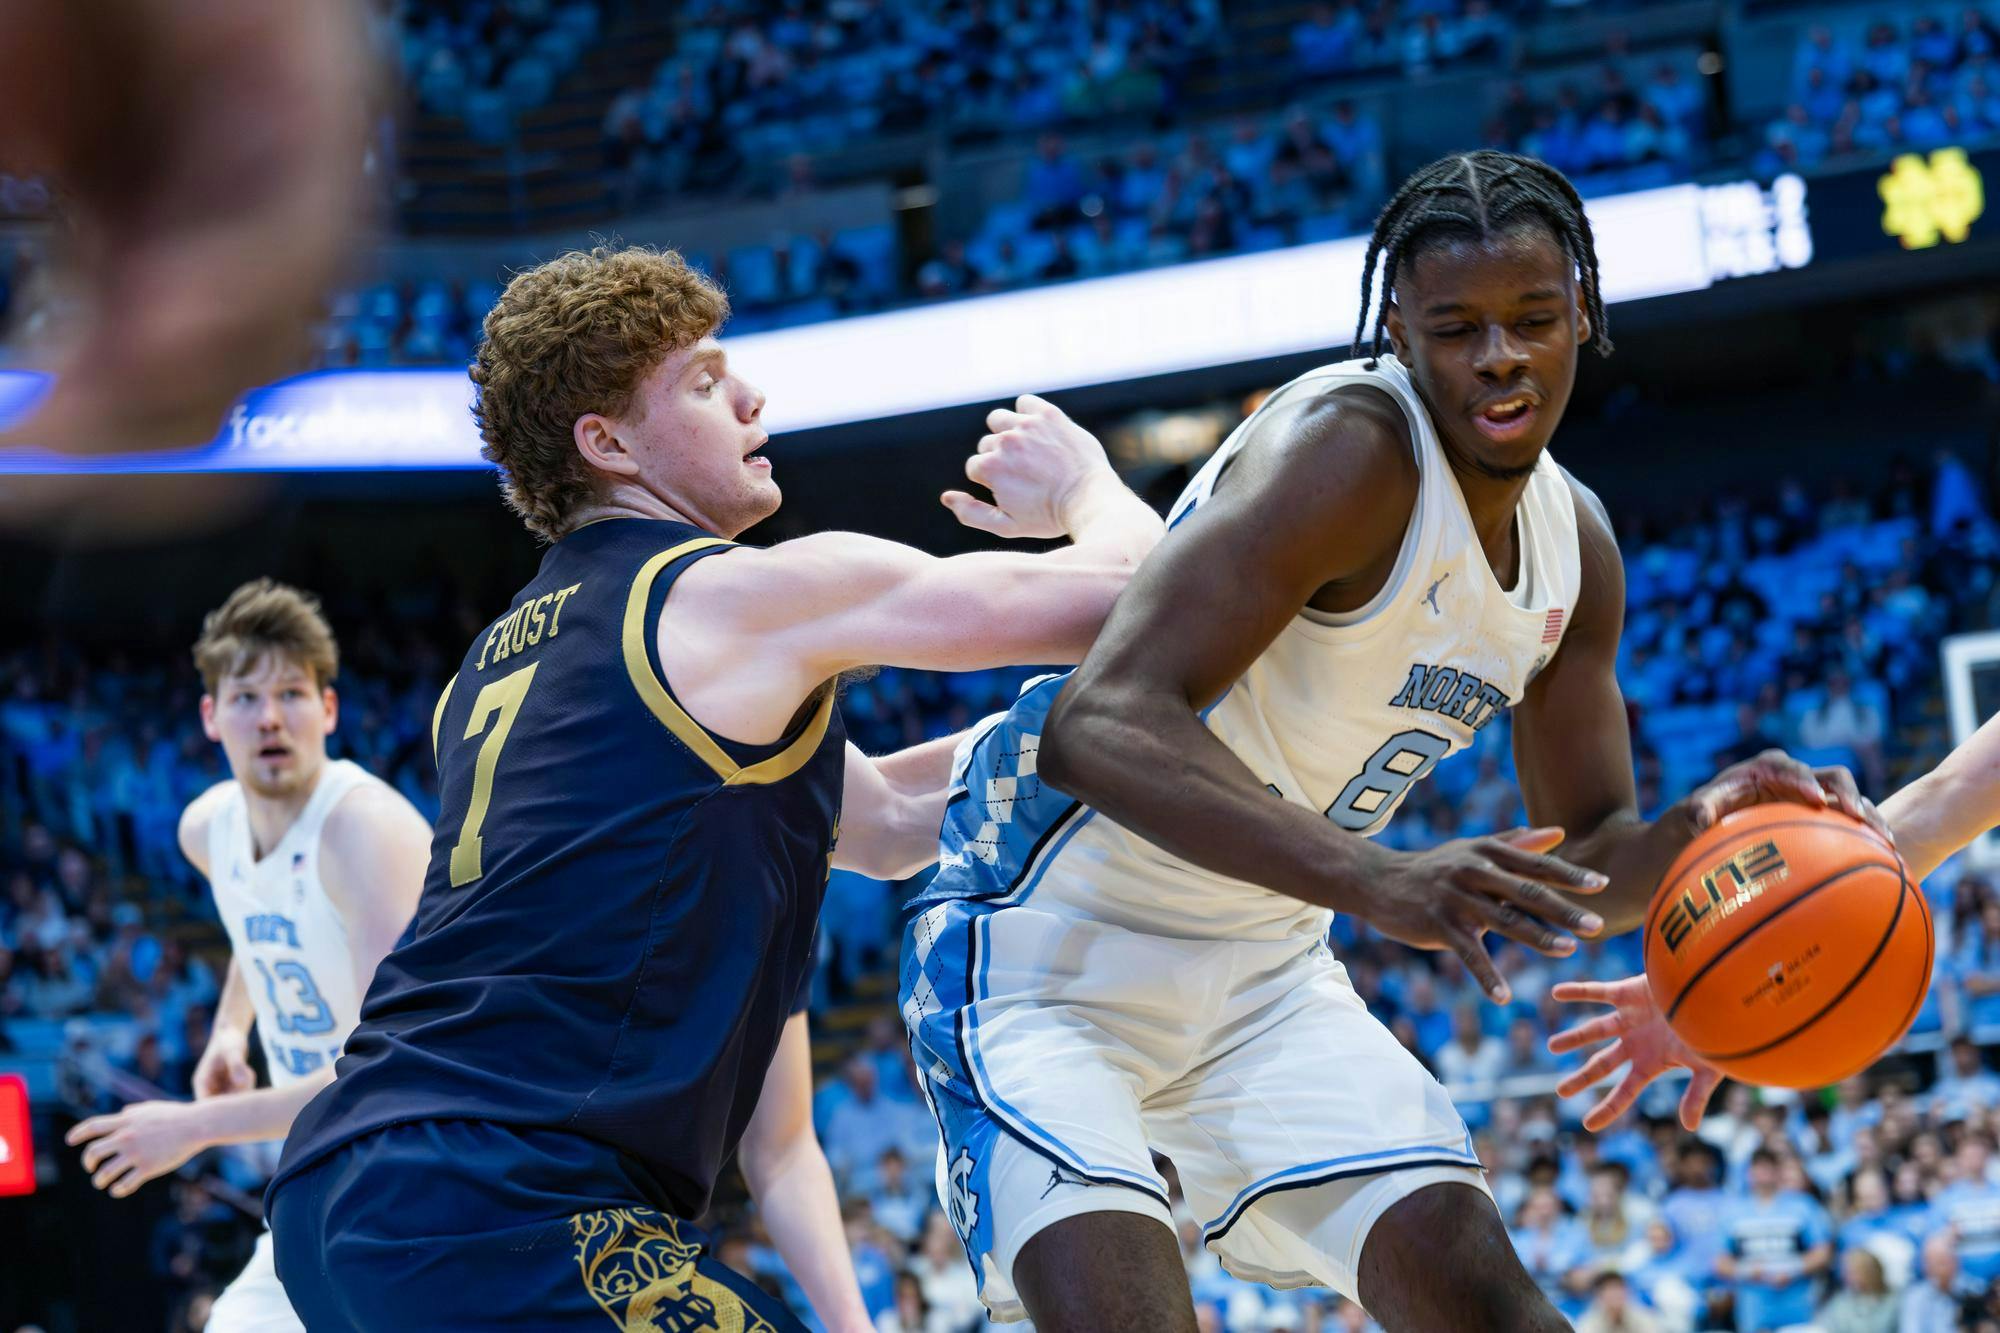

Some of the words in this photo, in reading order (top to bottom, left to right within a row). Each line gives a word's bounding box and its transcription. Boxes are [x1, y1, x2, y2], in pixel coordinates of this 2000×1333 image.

[475, 582, 582, 672] FROST
[450, 661, 540, 888] 7
[1323, 728, 1452, 831] 8
[1660, 838, 1787, 956] ELITE
[253, 957, 336, 1035] 13
